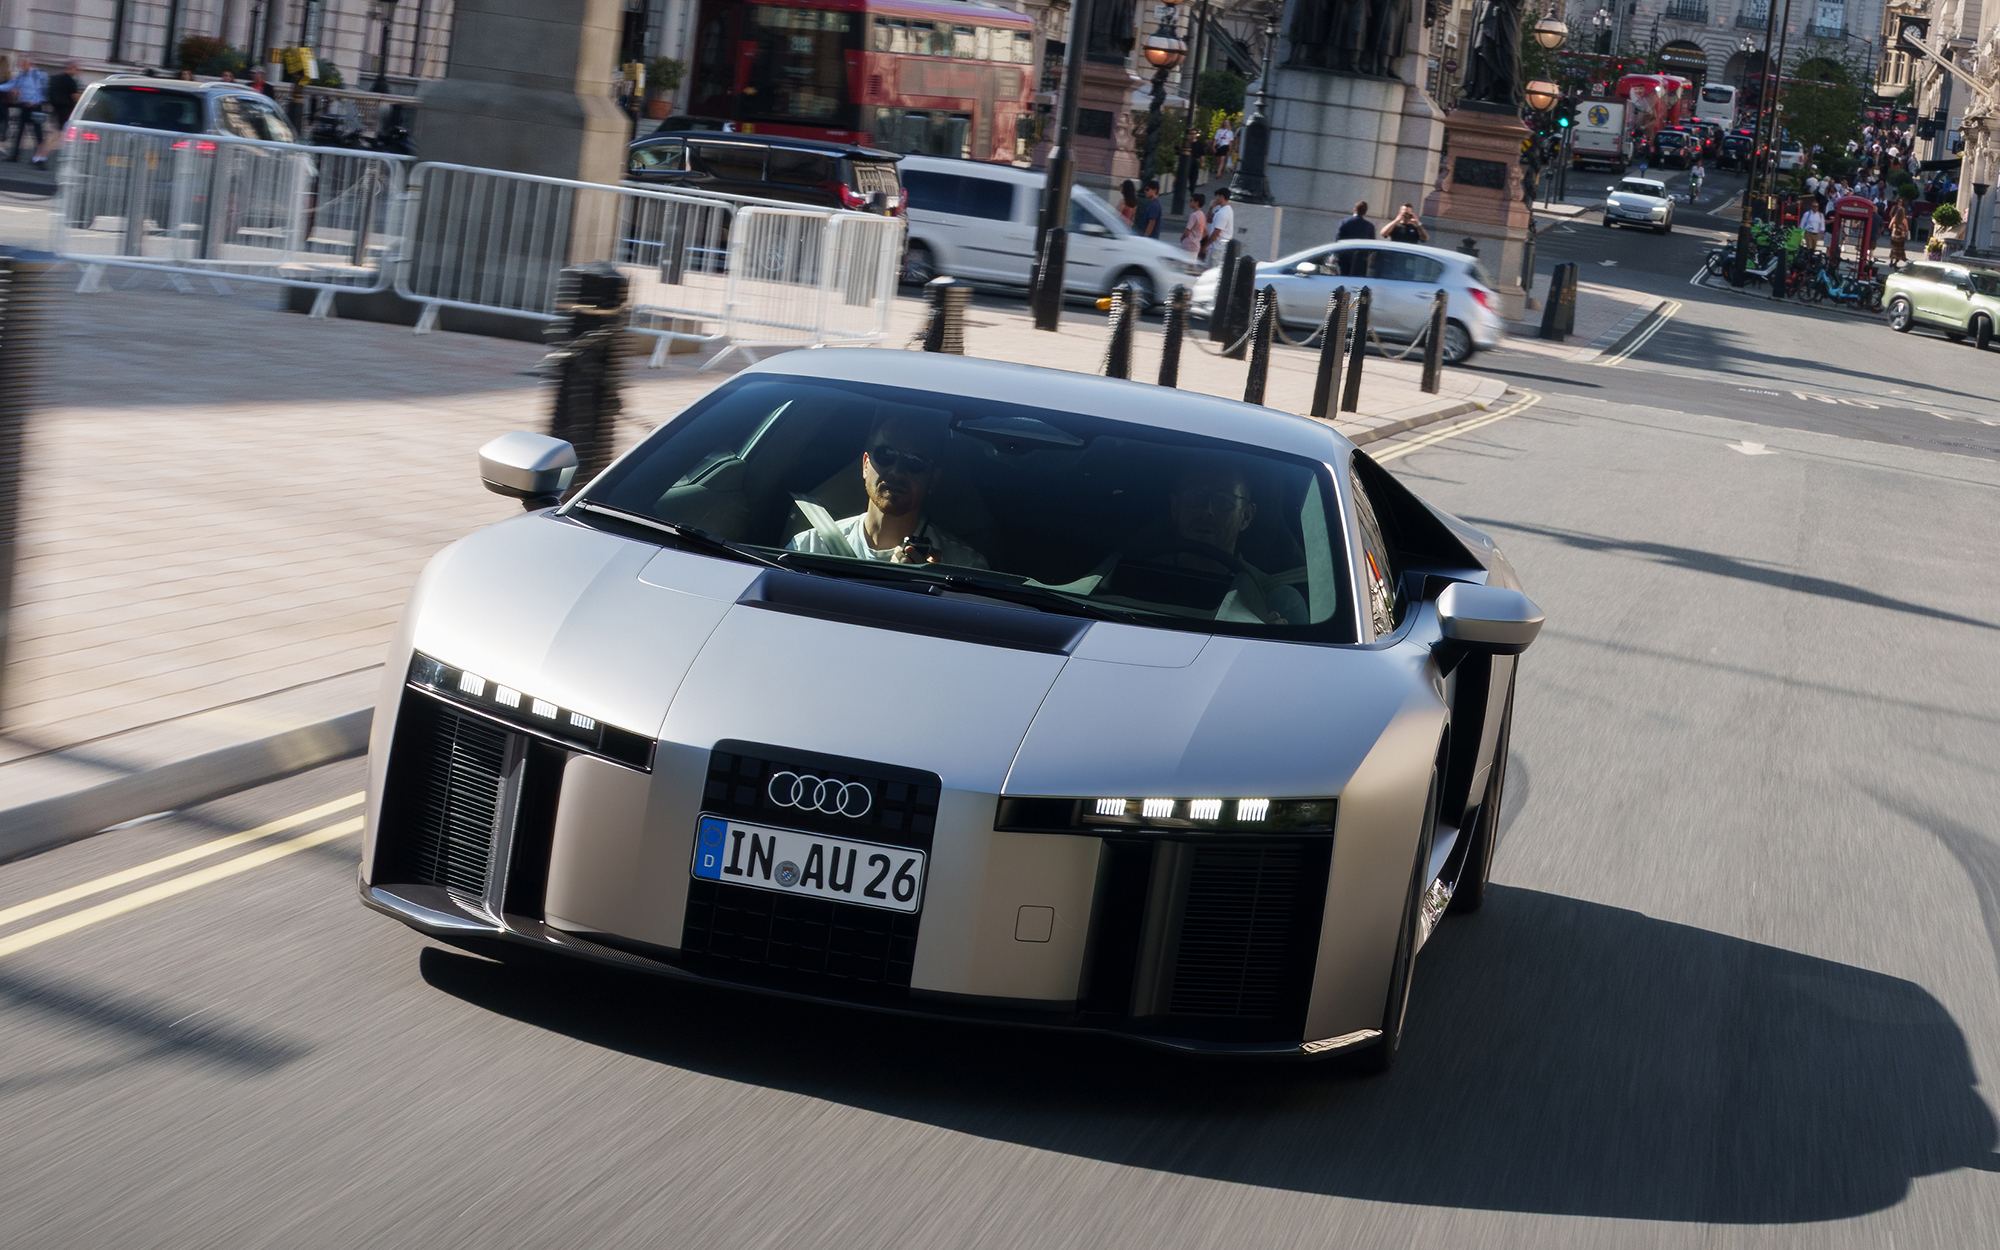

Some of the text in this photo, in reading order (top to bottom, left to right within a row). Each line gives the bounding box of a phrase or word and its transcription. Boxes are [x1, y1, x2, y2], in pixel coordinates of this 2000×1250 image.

[703, 854, 715, 868] D
[724, 830, 916, 902] IN AU 26
